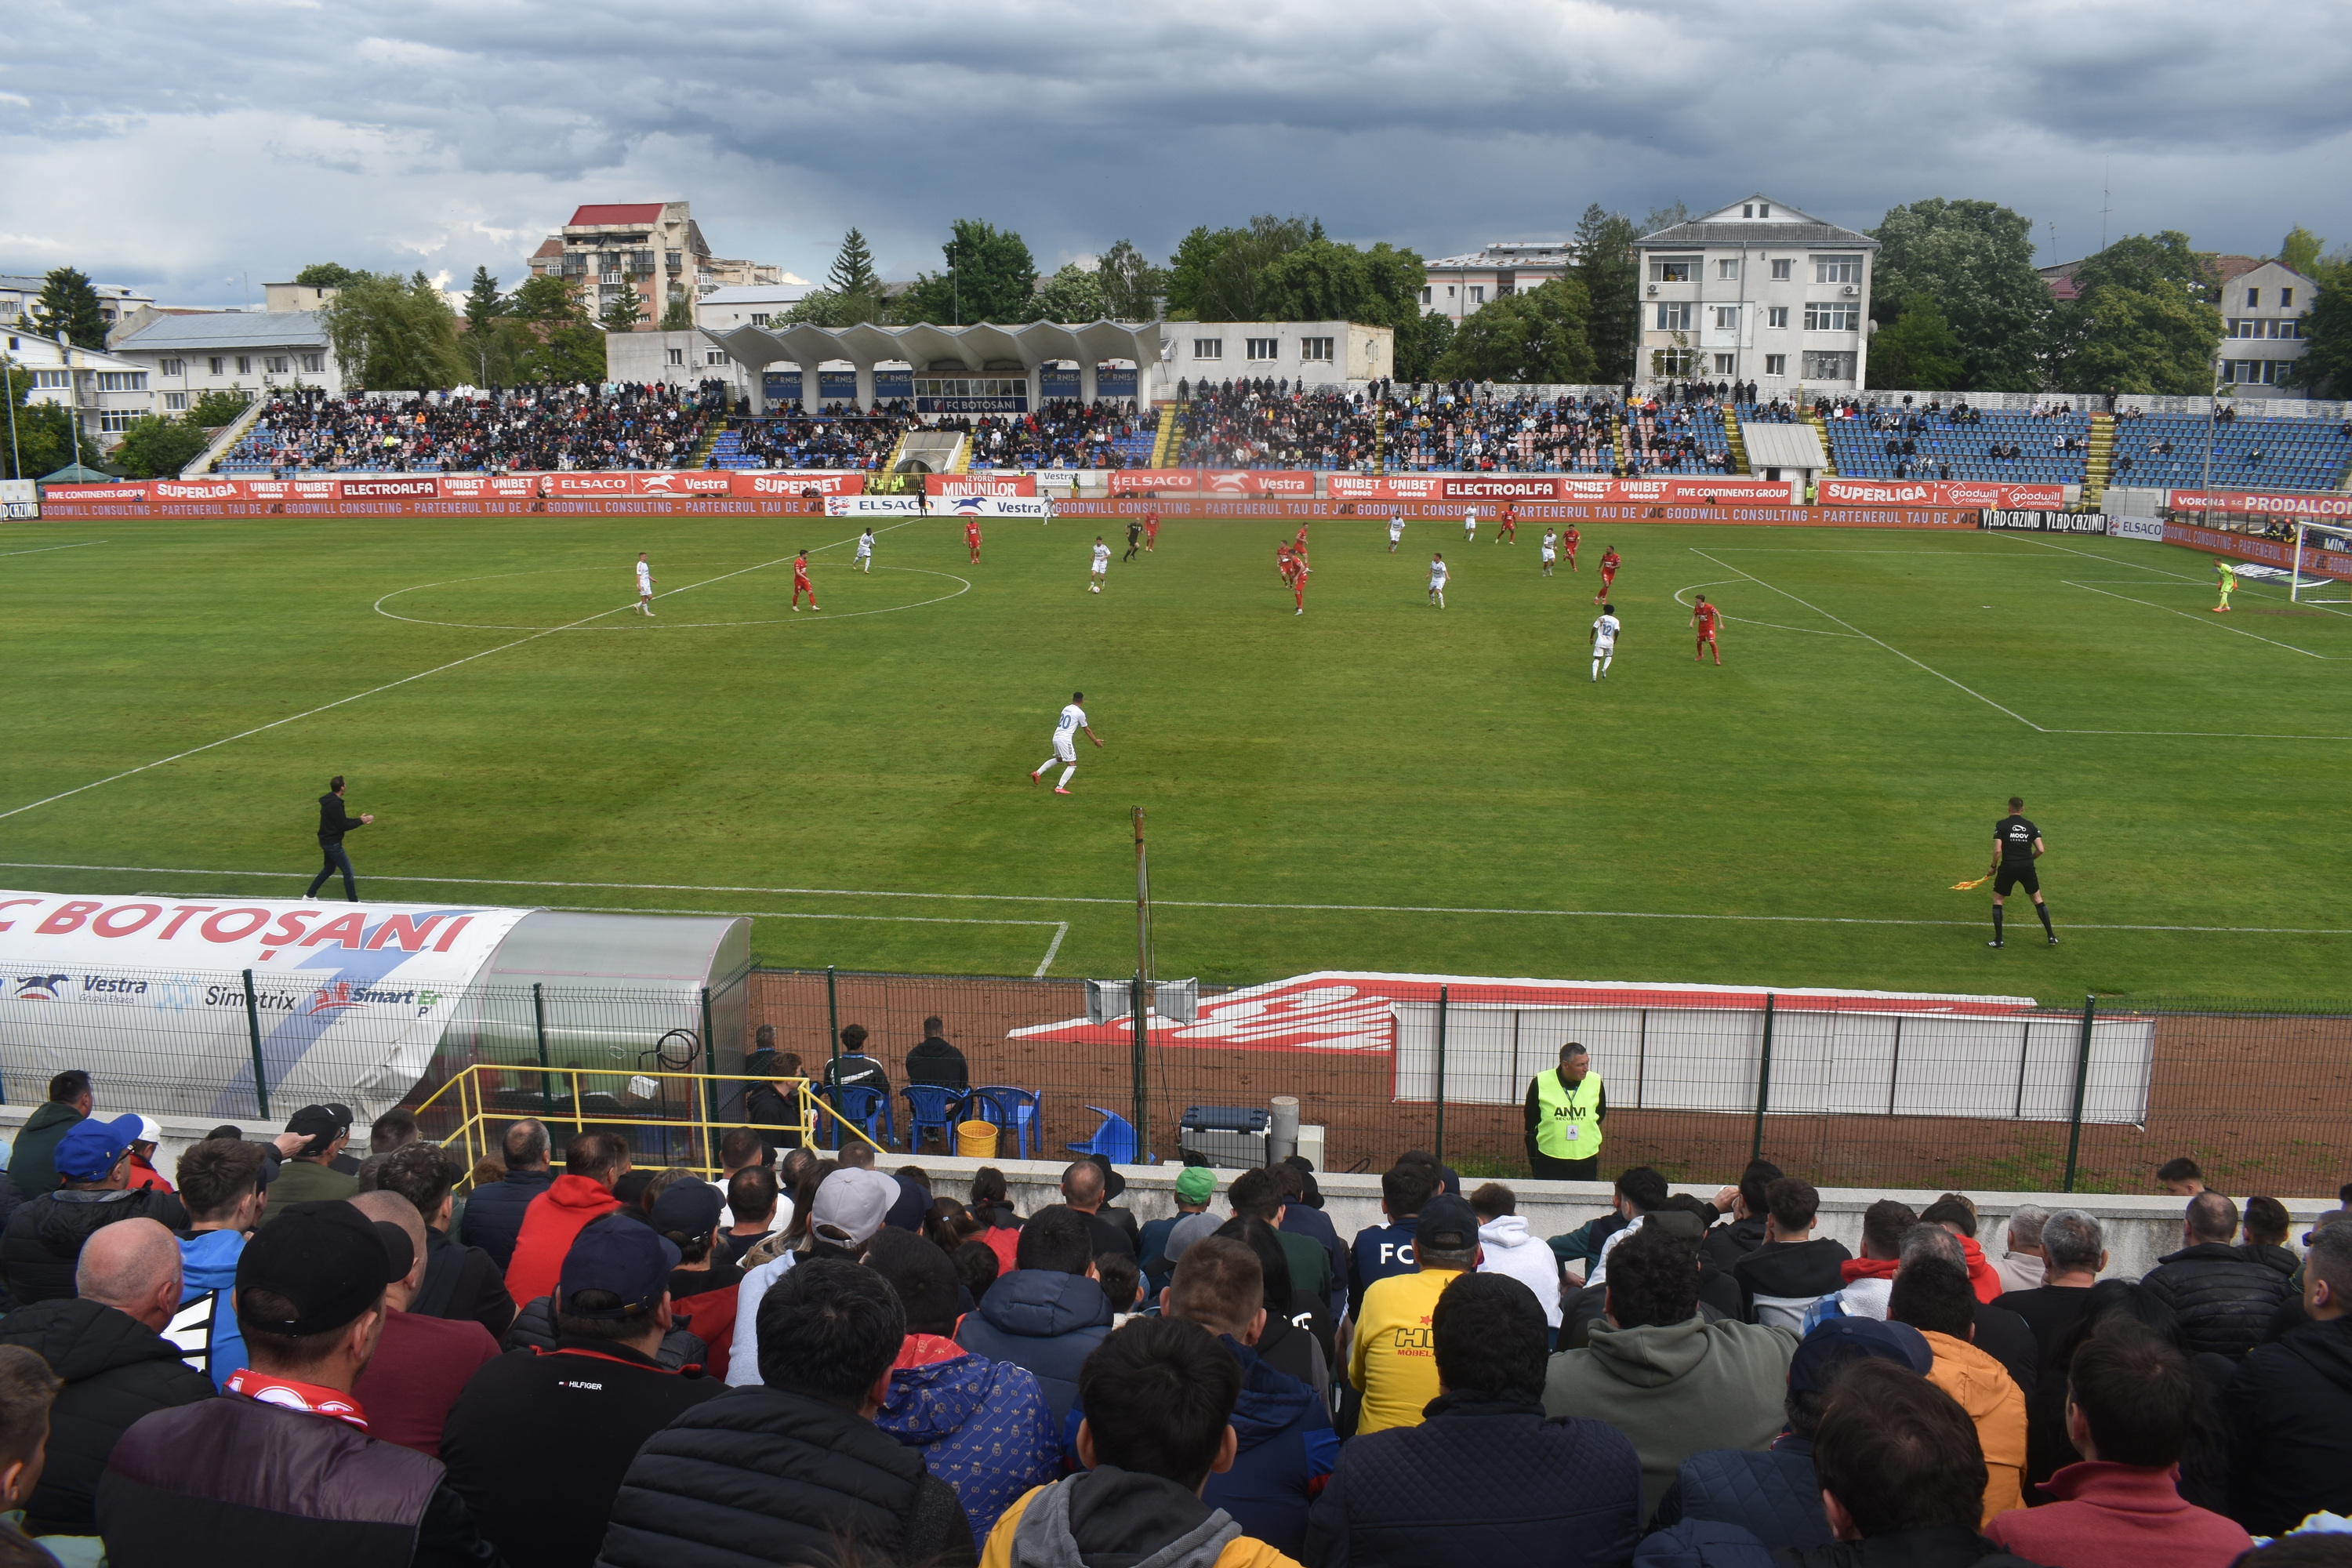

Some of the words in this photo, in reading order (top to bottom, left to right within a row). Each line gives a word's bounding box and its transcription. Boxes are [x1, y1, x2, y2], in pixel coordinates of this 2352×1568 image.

[946, 401, 959, 409] FC
[250, 482, 289, 492] UNIBET
[295, 482, 334, 492] UNIBET
[445, 479, 485, 489] UNIBET
[492, 478, 532, 489] UNIBET
[561, 479, 626, 489] ELSACO
[684, 478, 728, 490] Vestra
[753, 477, 842, 495] SUPERBET
[1121, 476, 1192, 486] ELSACO
[1258, 477, 1305, 490] Vestra
[1334, 478, 1381, 489] UNIBET
[1388, 480, 1436, 491] UNIBET
[1565, 481, 1613, 492] UNIBET
[1620, 481, 1668, 492] UNIBET
[65, 490, 115, 499] CONTINENTS
[117, 488, 146, 498] GROUP
[157, 483, 238, 499] SUPERLIGA
[344, 481, 434, 495] ELECTROALFA
[942, 482, 1018, 497] MINUNILOR
[1446, 483, 1553, 495] ELECTROALFA
[1677, 487, 1696, 497] FIVE
[1697, 488, 1755, 498] CONTINENTS
[1755, 488, 1788, 498] GROUP
[1828, 484, 1928, 502] SUPERLIGA
[1951, 488, 1998, 499] goodwill
[2013, 492, 2060, 502] goodwill
[2178, 496, 2226, 506] VORONA
[9, 503, 38, 519] CAZINO
[42, 505, 89, 516] GOODWILL
[91, 505, 150, 516] CONSULTING
[162, 504, 224, 516] PARTENERUL
[227, 504, 246, 515] TAU
[249, 504, 262, 515] DE
[265, 503, 284, 514] JOC
[285, 503, 336, 514] GOODWILL
[339, 503, 401, 514] CONSULTING
[415, 503, 481, 514] PARTENERUL
[485, 503, 505, 514] TAU
[508, 503, 521, 514] DE
[525, 503, 545, 514] JOC
[547, 503, 601, 514] GOODWILL
[605, 502, 672, 514] CONSULTING
[685, 502, 757, 514] PARTENERUL
[760, 502, 781, 513] TAU
[784, 502, 800, 513] DE
[803, 501, 824, 513] JOC
[996, 502, 1041, 514] Vestra
[1055, 503, 1114, 514] GOODWILL
[1119, 503, 1190, 514] CONSULTING
[1206, 503, 1282, 514] PARTENERUL
[1287, 503, 1308, 514] TAU
[1313, 503, 1327, 514] DE
[1332, 503, 1355, 515] JOC
[1357, 503, 1417, 516] GOODWILL
[1422, 504, 1497, 517] CONSULING
[1512, 506, 1589, 517] PARTENERUL
[1595, 506, 1617, 518] TAU
[1621, 506, 1637, 518] DE
[1641, 506, 1664, 519] JOC
[1666, 507, 1728, 519] GOODWILL
[1733, 509, 1808, 522] CONSULTING
[1823, 510, 1901, 523] PARTENERUL
[1906, 512, 1929, 524] TAU
[1933, 512, 1948, 524] DE
[1953, 512, 1976, 524] JOC
[1983, 509, 2005, 528] VLAD
[2007, 510, 2040, 530] CAZINO
[2045, 511, 2071, 532] VLAD
[2071, 514, 2105, 533] CAZINO
[2122, 521, 2162, 535] ELSACO
[2163, 527, 2191, 542] GOODWILL
[2193, 531, 2232, 550] CONSULTING
[2238, 541, 2281, 561] PARTENERUL
[1602, 623, 1612, 636] 12
[1058, 713, 1072, 729] 20
[34, 900, 475, 962] BOTOȘANI
[83, 975, 147, 994] Vestra
[79, 993, 107, 1004] Grupul
[109, 995, 134, 1004] Elsaco
[350, 987, 415, 1004] Smart
[1553, 1106, 1586, 1117] ANVI
[1379, 1243, 1414, 1265] FC
[1397, 1348, 1432, 1357] MÖBEL
[568, 1381, 602, 1390] HILFIGER
